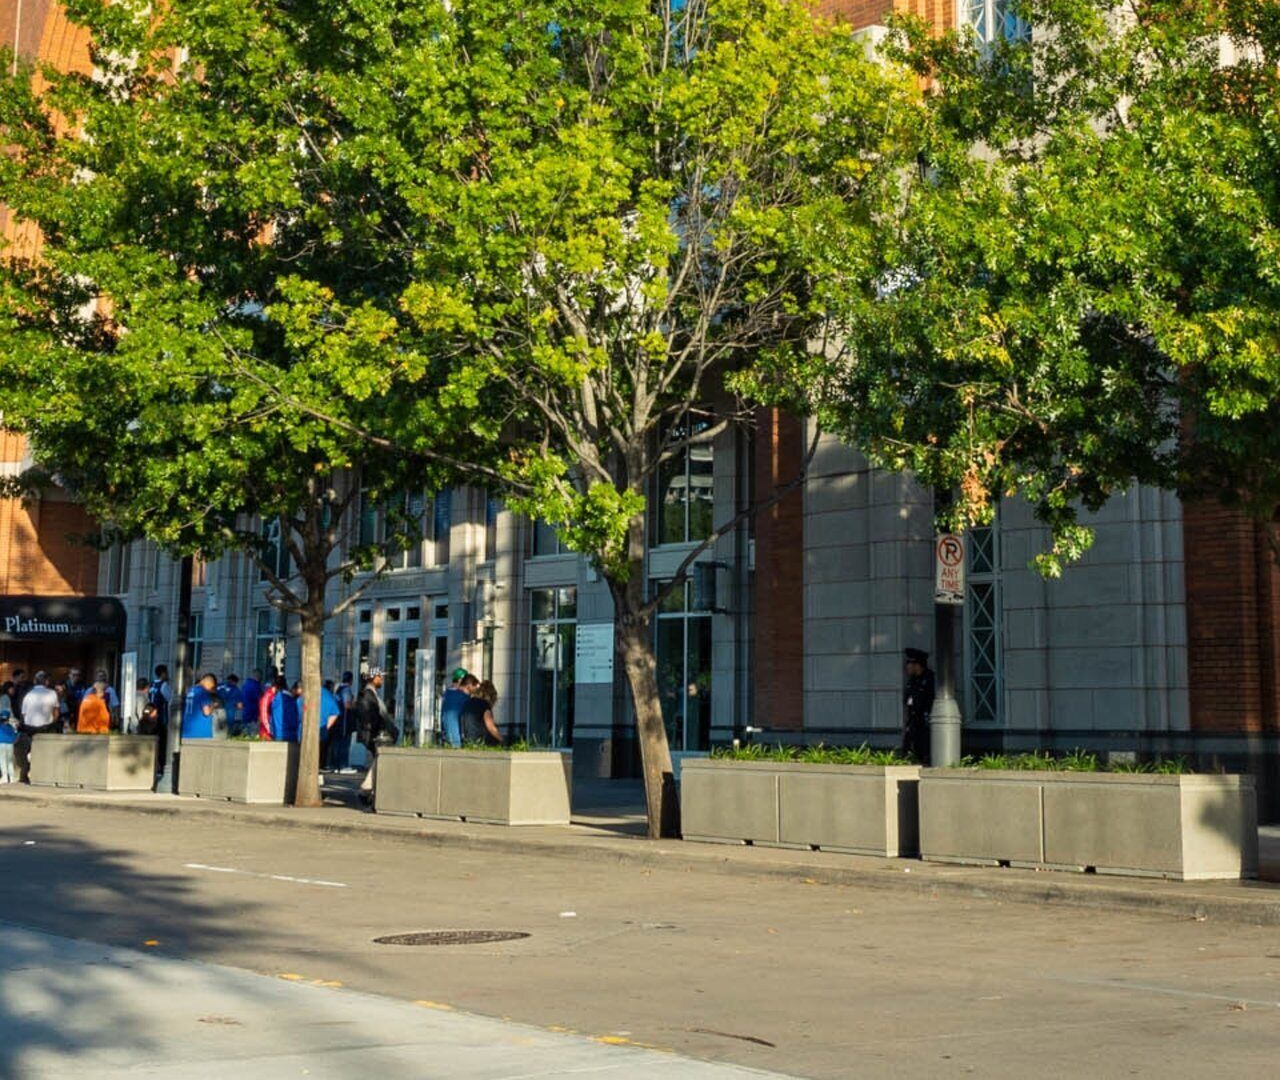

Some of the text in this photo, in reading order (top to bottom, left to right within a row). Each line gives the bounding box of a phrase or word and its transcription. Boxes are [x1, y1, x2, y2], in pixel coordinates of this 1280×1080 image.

[942, 567, 960, 578] ANY
[941, 579, 961, 591] TIME
[5, 615, 70, 633] Platinum
